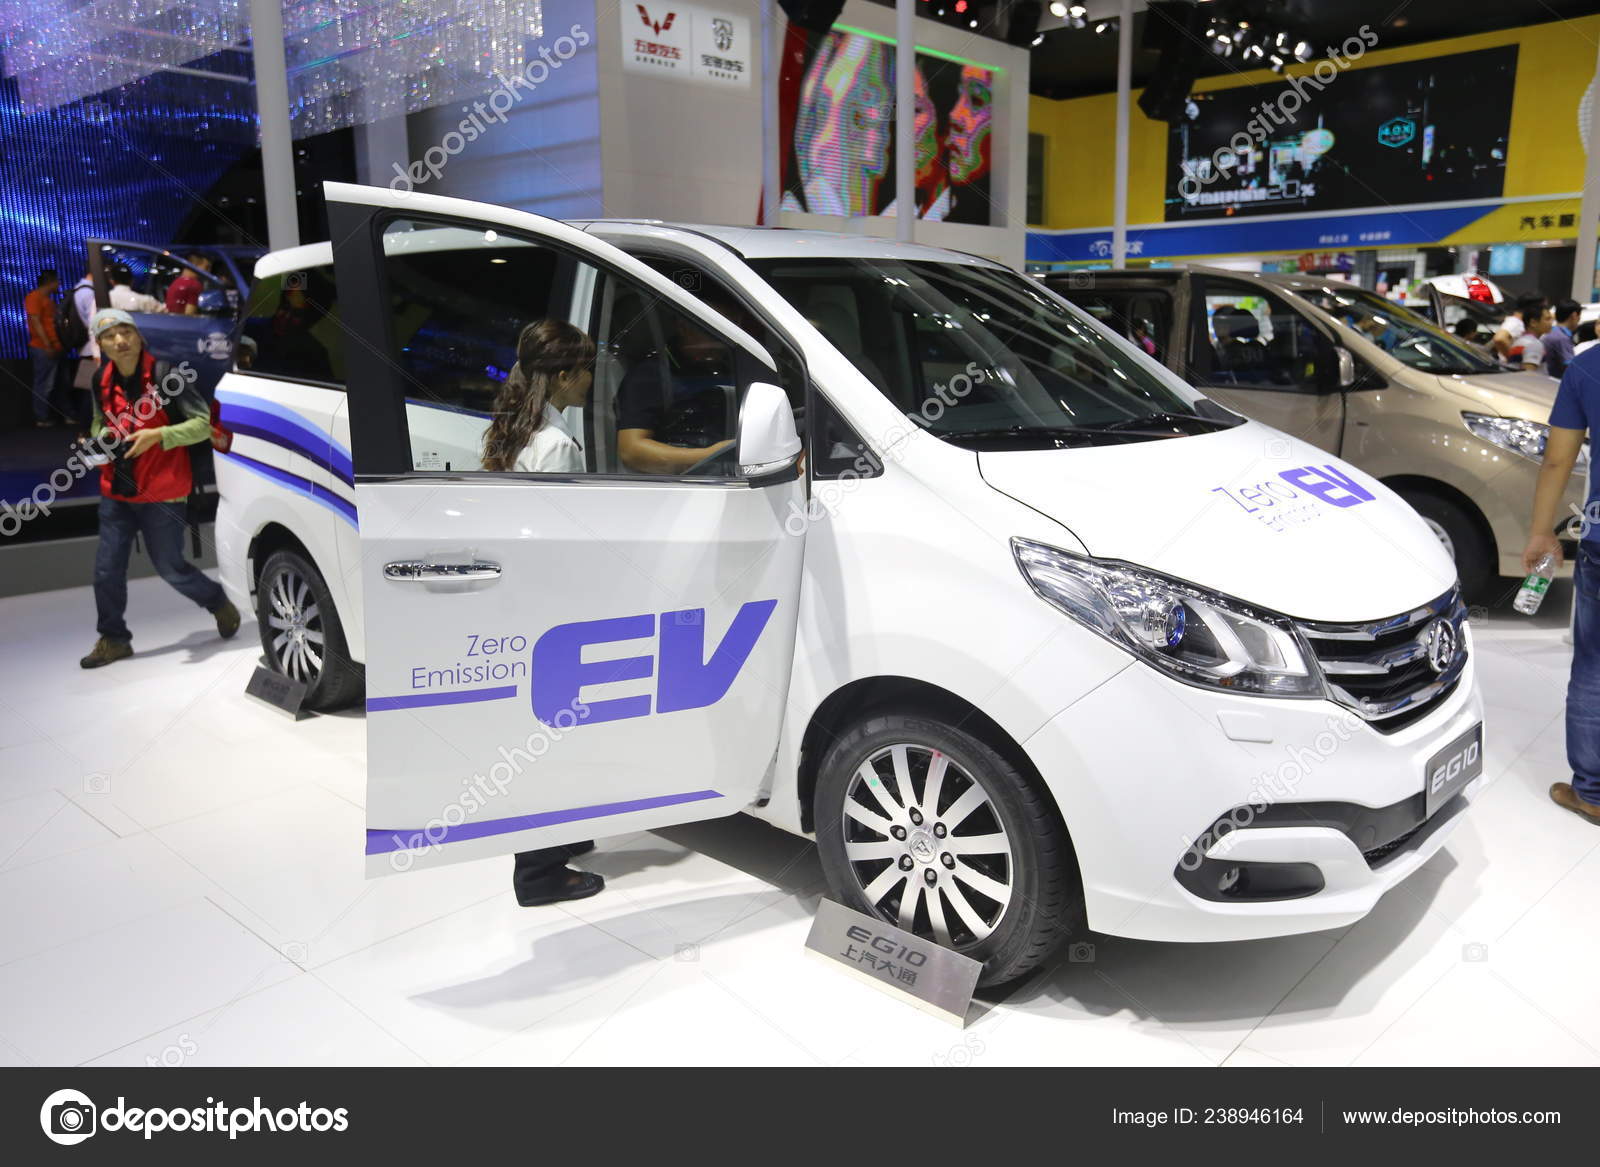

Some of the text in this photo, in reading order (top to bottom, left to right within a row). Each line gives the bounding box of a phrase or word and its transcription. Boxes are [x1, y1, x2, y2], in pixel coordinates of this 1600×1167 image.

[634, 38, 682, 60] 五菱汽车
[1519, 212, 1581, 231] 汽车服
[1212, 481, 1298, 513] Zero
[1278, 464, 1377, 508] EV
[466, 634, 527, 657] Zero
[531, 598, 778, 729] EV
[411, 660, 526, 689] Emission
[1431, 740, 1479, 795] EG10
[840, 944, 918, 986] 上汽大通
[846, 925, 927, 968] EG10
